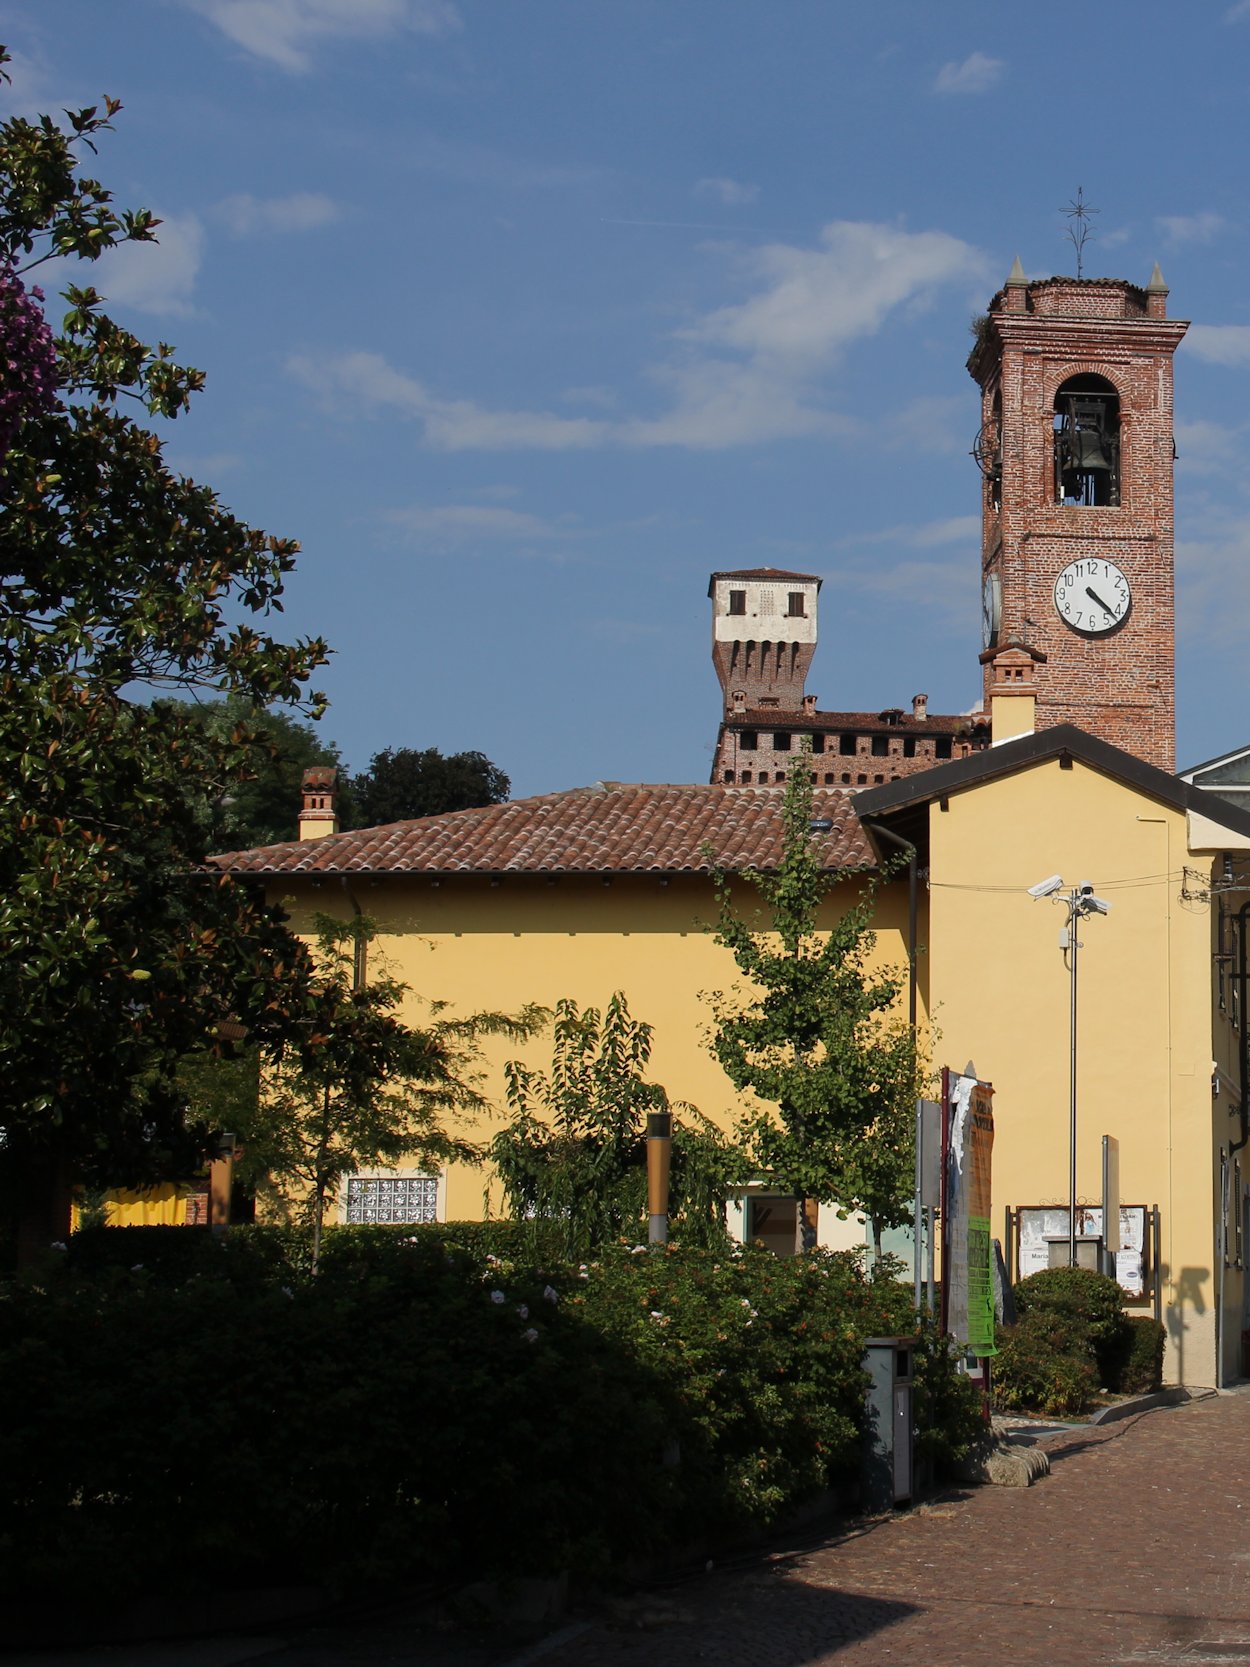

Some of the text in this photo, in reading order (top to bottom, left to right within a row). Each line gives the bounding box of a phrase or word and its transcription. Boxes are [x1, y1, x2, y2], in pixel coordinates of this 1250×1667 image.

[1075, 564, 1083, 577] 11
[1087, 562, 1098, 575] 12
[1064, 574, 1073, 587] 10
[1114, 576, 1122, 588] 2
[1059, 587, 1065, 600] 9
[1120, 590, 1126, 602] 3
[1065, 602, 1070, 614] 8
[1114, 604, 1121, 616] 4
[1076, 612, 1082, 624] 7
[1089, 615, 1096, 627] 6
[1103, 613, 1110, 625] 5
